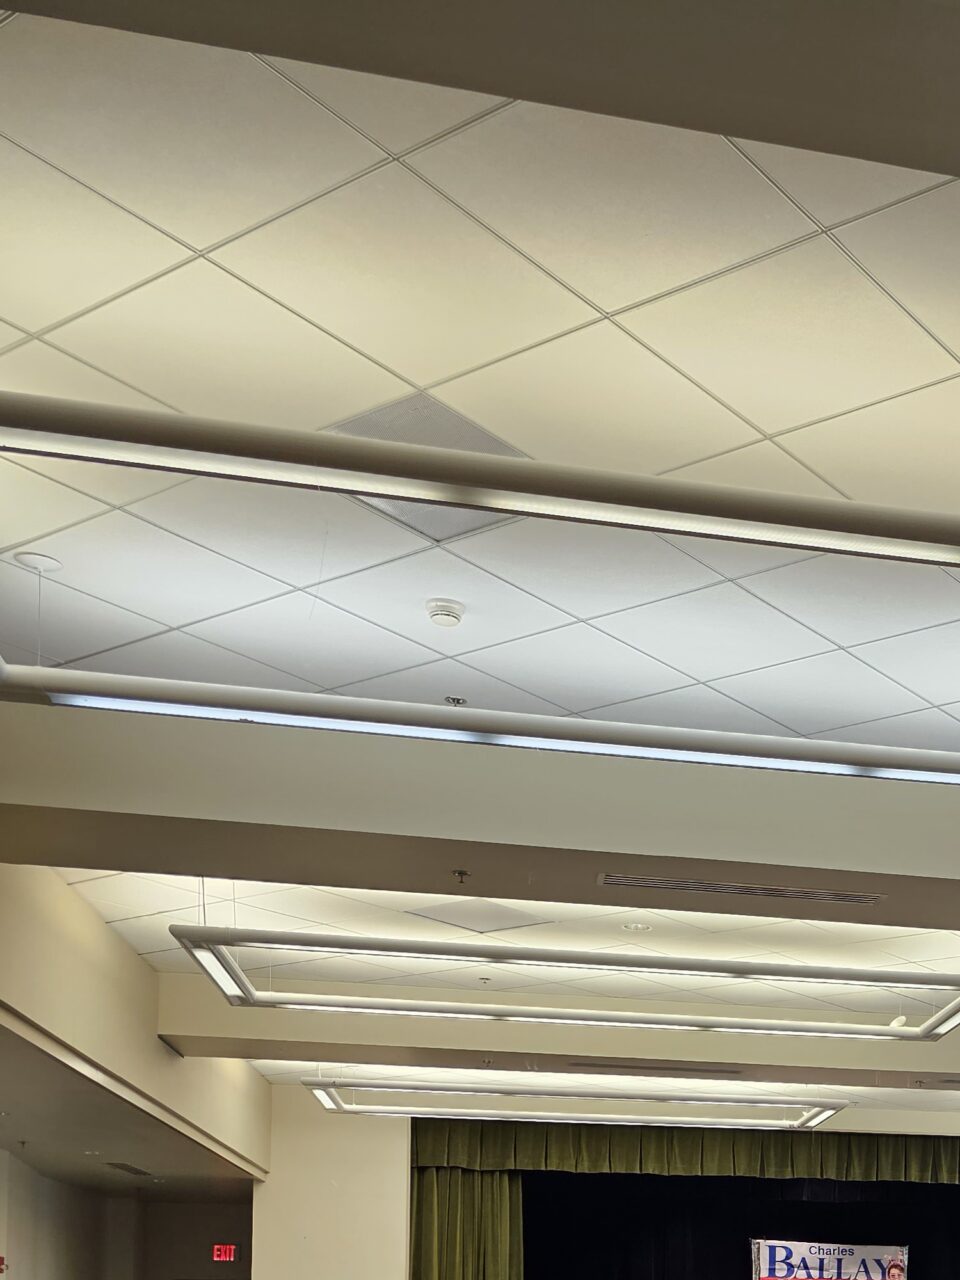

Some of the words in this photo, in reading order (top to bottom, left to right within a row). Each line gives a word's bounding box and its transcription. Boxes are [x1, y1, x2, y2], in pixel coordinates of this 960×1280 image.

[213, 1244, 236, 1262] EXIT
[808, 1245, 855, 1257] Charles
[766, 1244, 890, 1280] BALLAY
